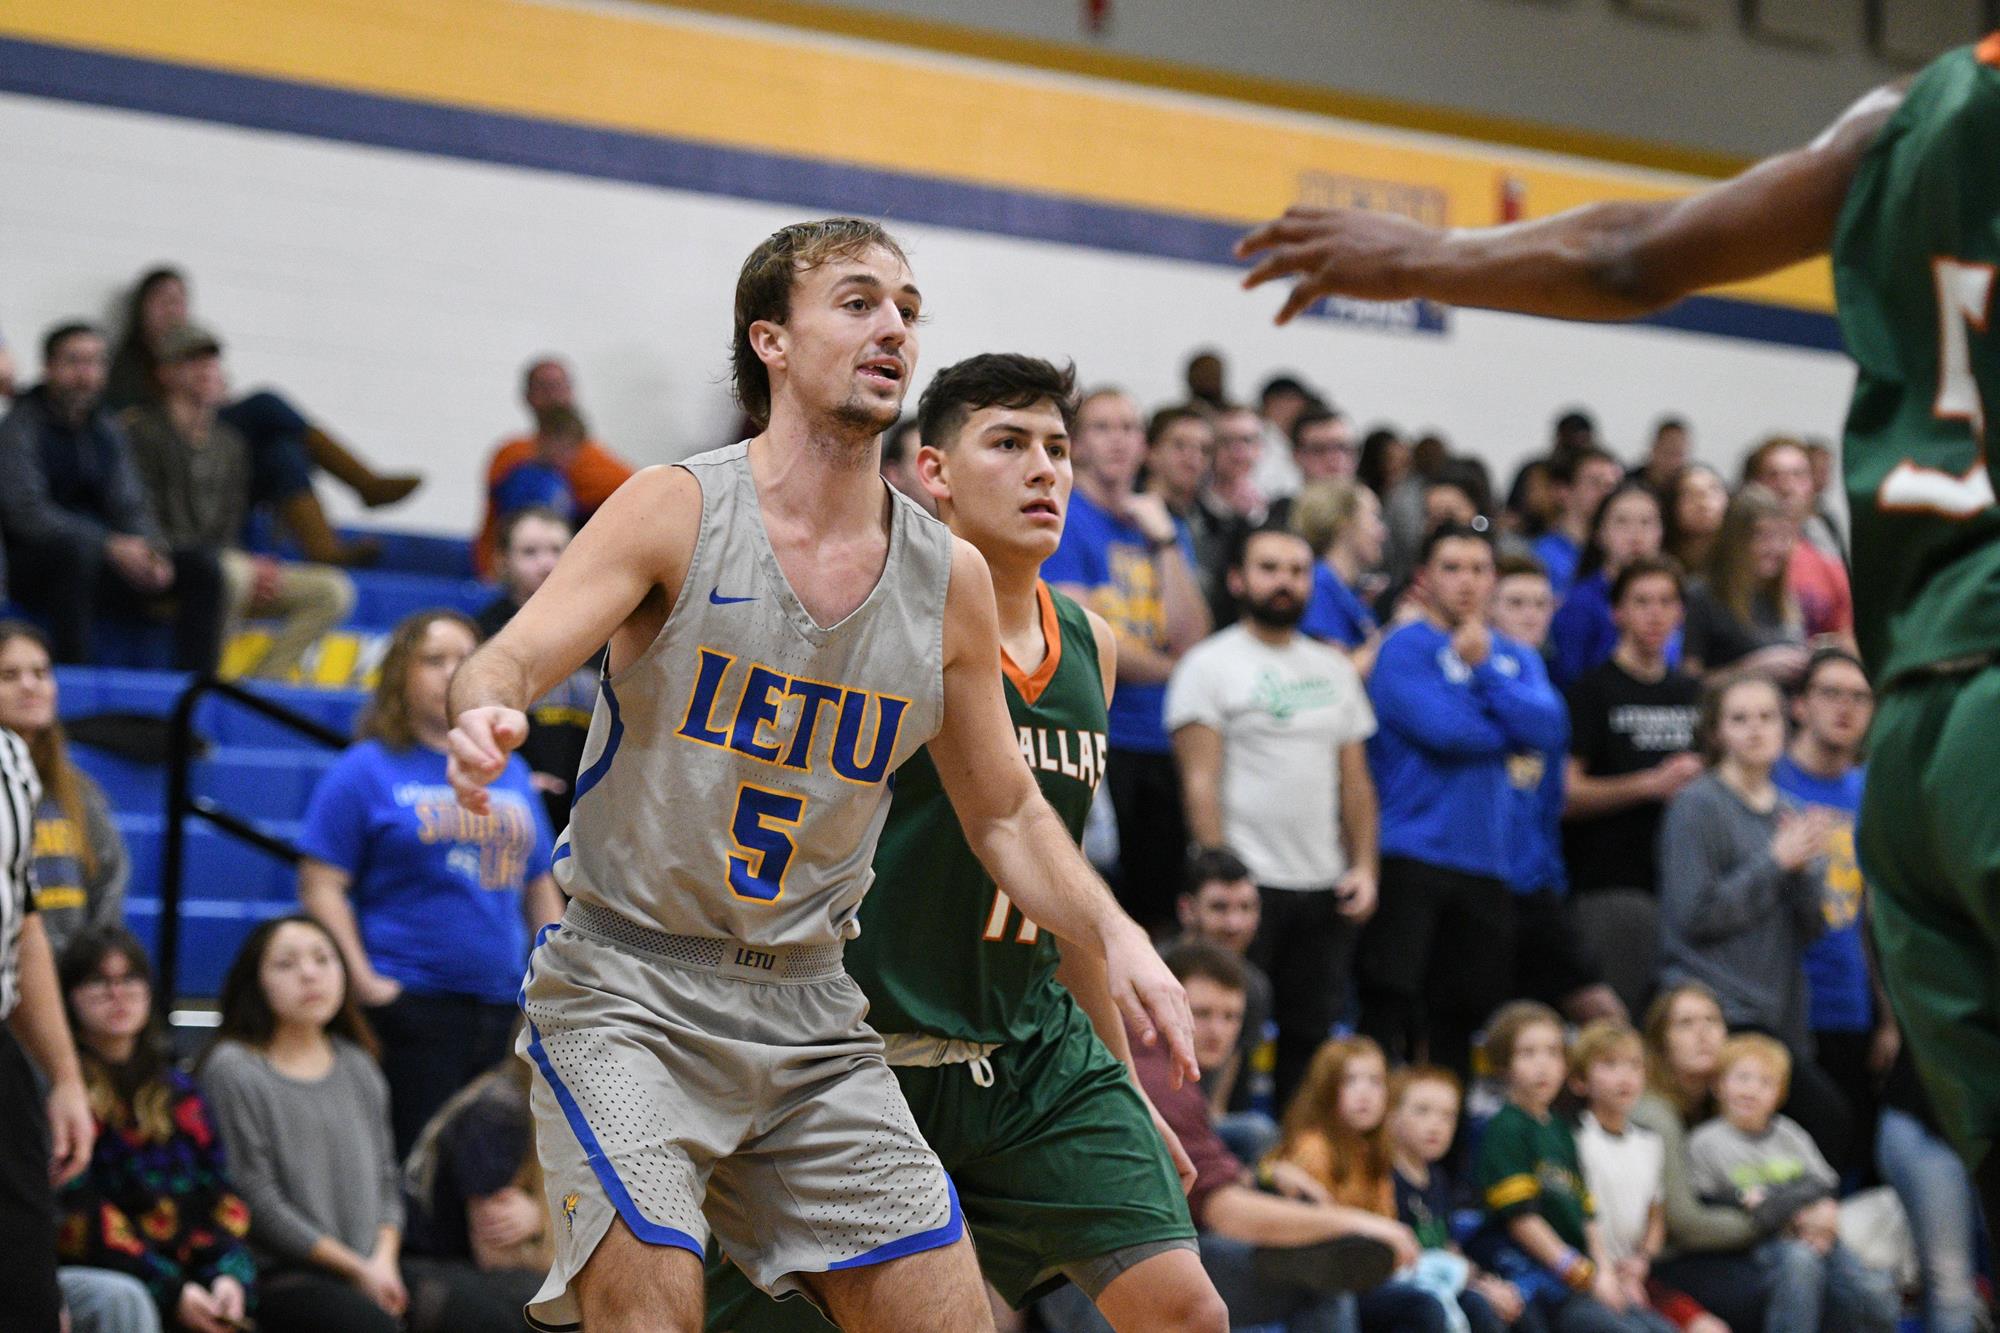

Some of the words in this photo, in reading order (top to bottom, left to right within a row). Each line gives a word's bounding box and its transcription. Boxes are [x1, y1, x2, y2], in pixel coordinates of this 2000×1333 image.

[1878, 255, 1997, 520] 5
[673, 644, 913, 787] LETU
[1017, 726, 1107, 799] ALLAS
[724, 781, 807, 906] 5
[734, 947, 776, 971] LETU
[982, 887, 1039, 945] 1
